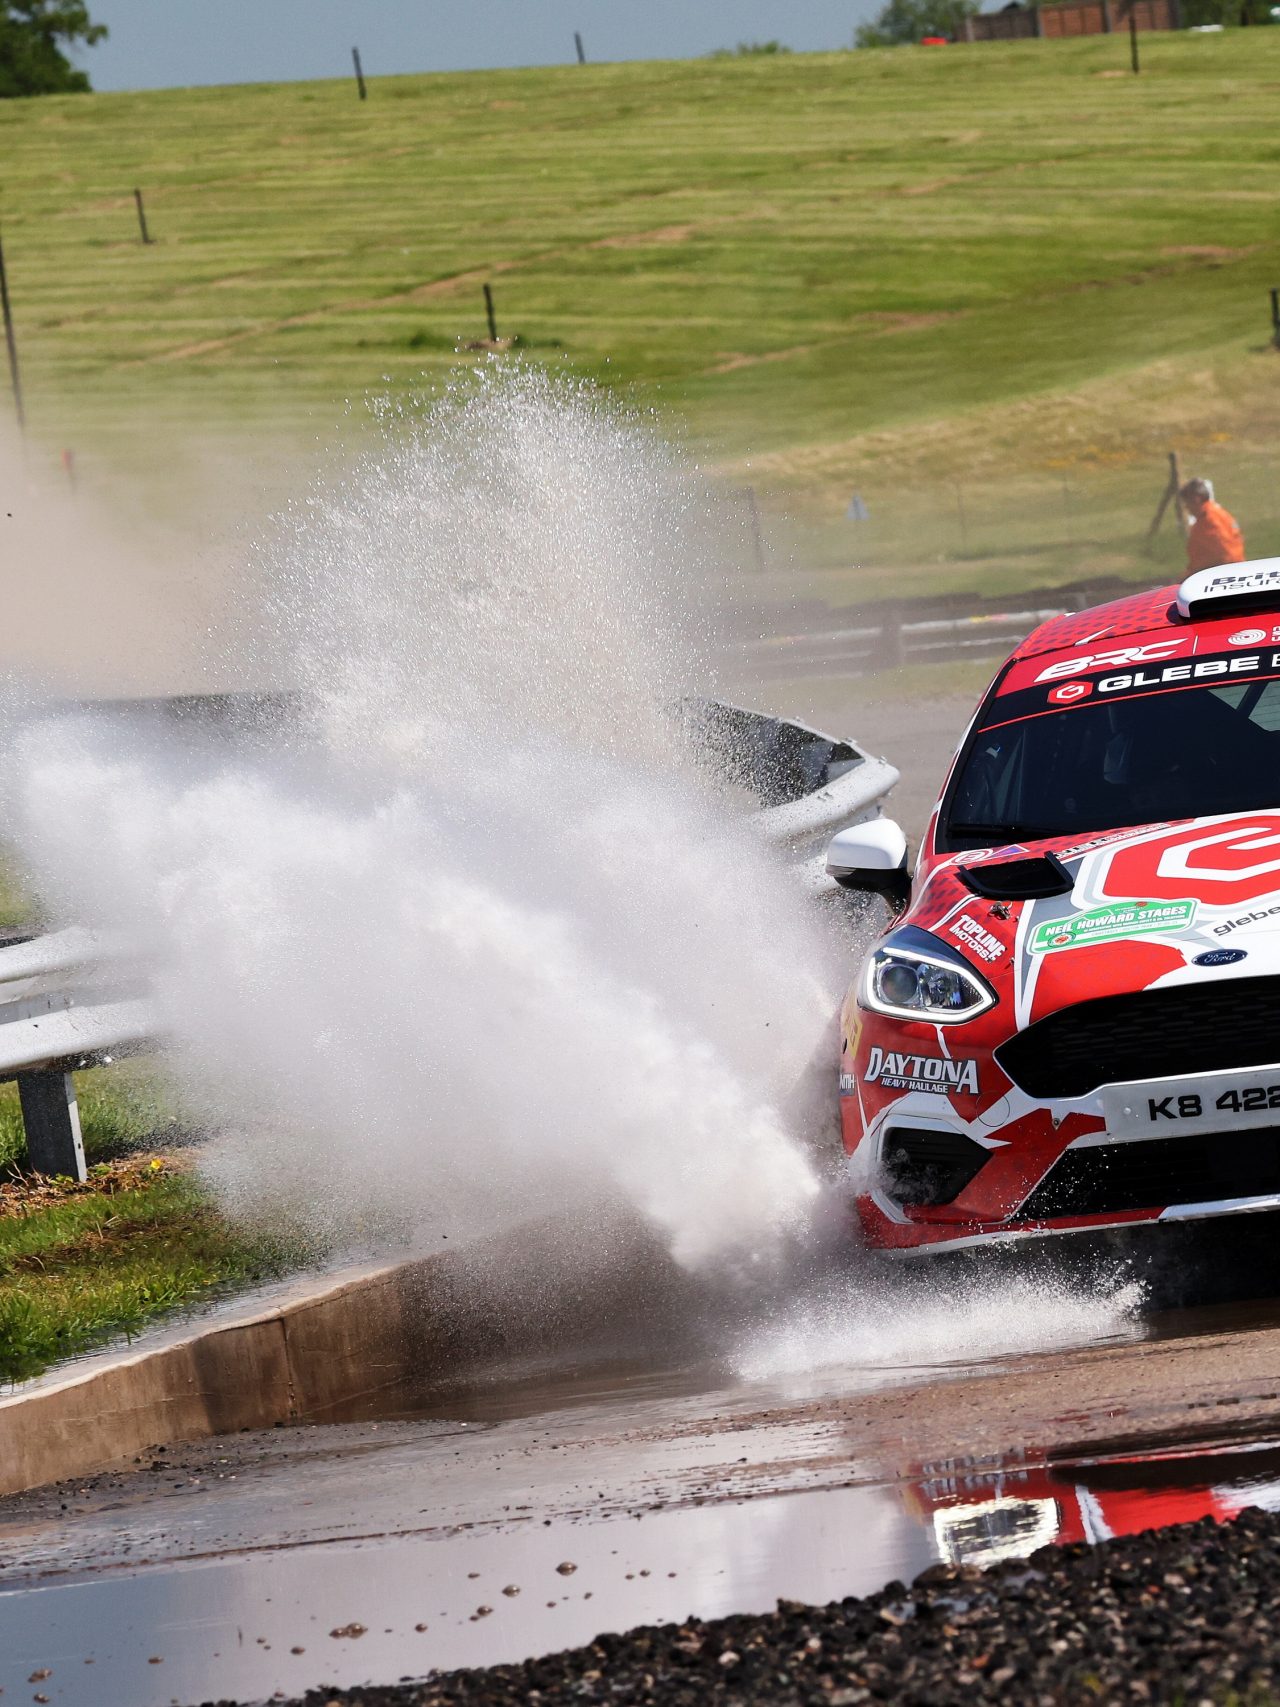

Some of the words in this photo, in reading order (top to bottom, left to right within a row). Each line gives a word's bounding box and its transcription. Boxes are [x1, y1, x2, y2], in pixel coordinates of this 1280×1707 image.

[1034, 637, 1189, 683] BRC
[1097, 655, 1261, 693] GLEBE
[949, 914, 1007, 961] TOPLINE
[1045, 921, 1074, 937] NEIL
[1077, 911, 1135, 931] HOWARD
[1137, 905, 1187, 920] STAGES
[1203, 951, 1237, 965] Ford
[864, 1047, 979, 1094] DAYTONA
[880, 1077, 907, 1089] HEAVY
[908, 1081, 949, 1094] HAULAGE
